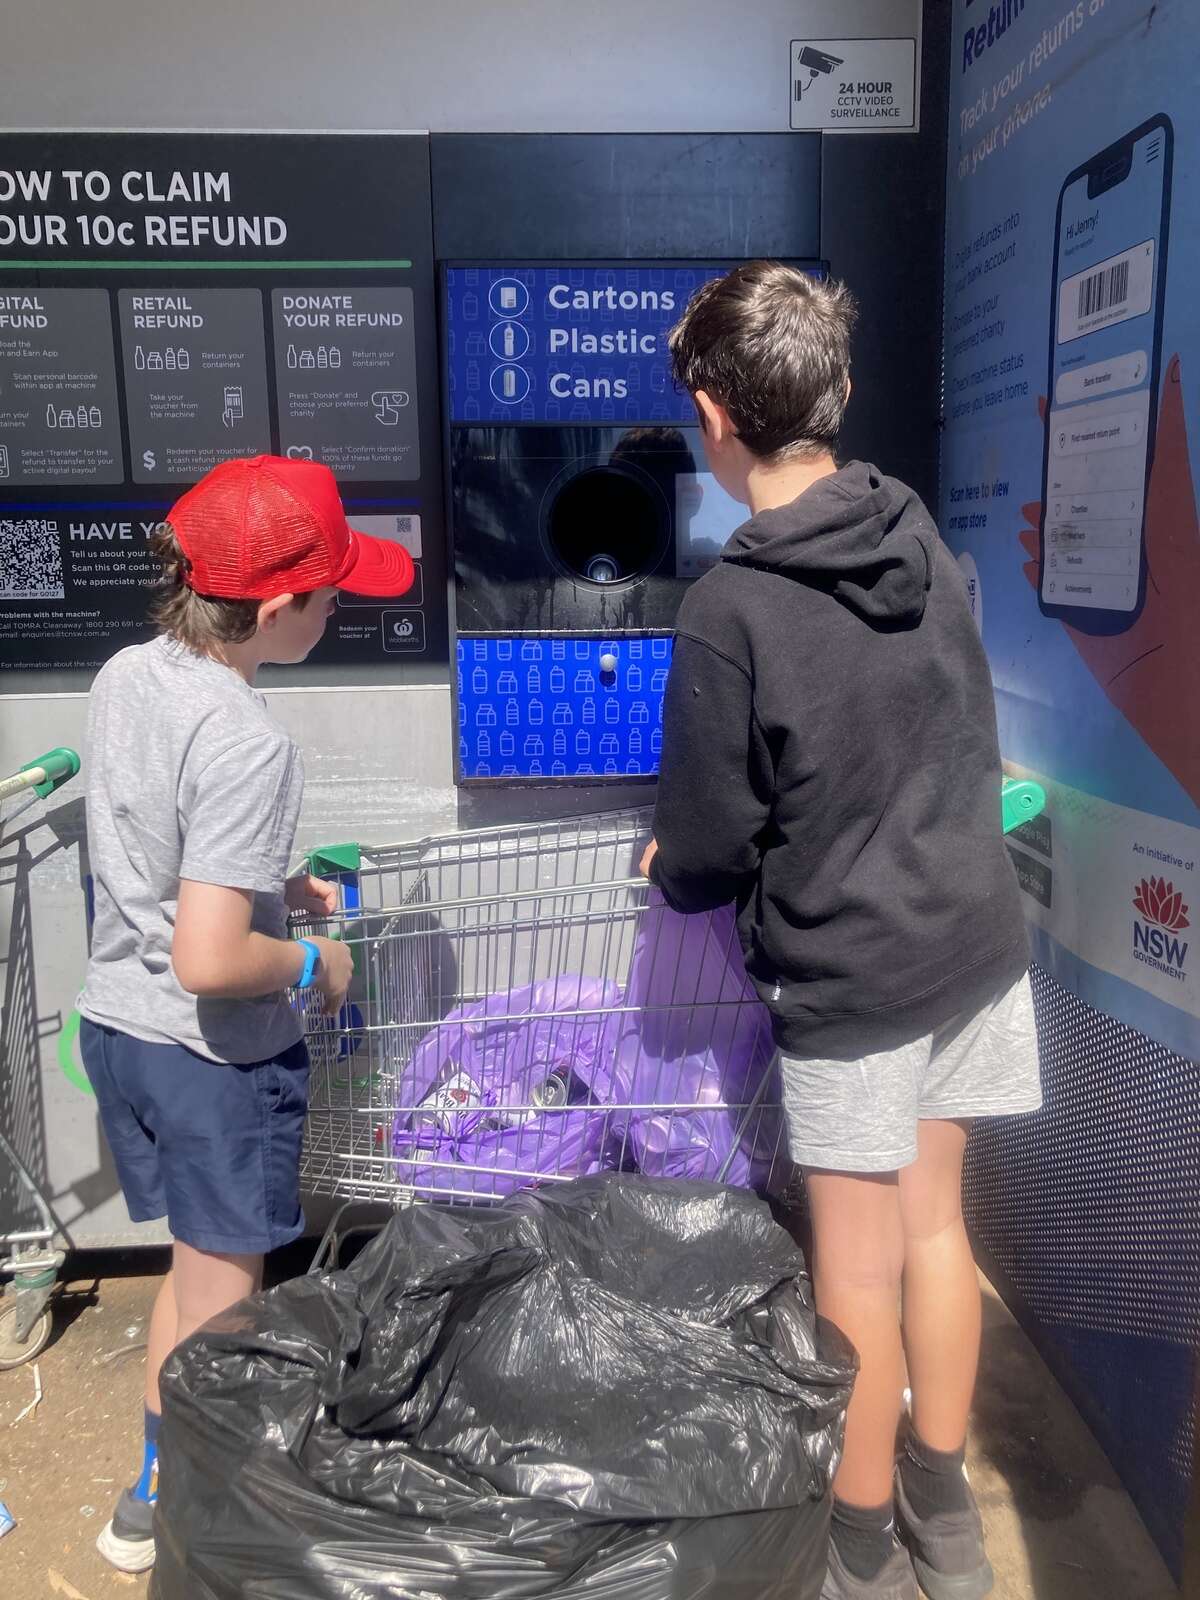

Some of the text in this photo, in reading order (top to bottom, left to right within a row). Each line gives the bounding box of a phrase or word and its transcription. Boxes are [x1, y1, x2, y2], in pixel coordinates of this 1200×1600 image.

[959, 3, 1084, 136] Track your returns
[838, 82, 893, 94] 24 HOUR
[837, 96, 894, 106] CCTV VIDEO
[830, 108, 901, 118] SURVEILLANCE
[971, 126, 1001, 175] your
[1002, 83, 1053, 149] phone.
[62, 171, 111, 202] TO
[121, 171, 232, 203] CLAIM
[76, 215, 135, 247] 10c
[145, 215, 288, 247] REFUND
[1066, 225, 1074, 240] Hi
[984, 241, 1016, 274] account
[282, 296, 353, 310] DONATE
[548, 284, 676, 311] Cartons
[132, 296, 192, 311] RETAIL
[134, 315, 204, 328] REFUND
[284, 313, 403, 327] YOUR REFUND
[19, 340, 31, 348] the
[549, 328, 657, 354] Plastic
[42, 350, 58, 359] App
[201, 352, 246, 361] Return your
[352, 351, 396, 360] Return your
[999, 352, 1025, 377] status
[34, 373, 66, 382] personal
[65, 382, 96, 390] machine
[549, 372, 629, 399] Cans
[1003, 380, 1028, 401] home
[149, 393, 184, 403] Take your
[150, 402, 179, 410] voucher
[317, 402, 333, 410] your
[335, 401, 369, 409] preferred
[13, 412, 29, 420] your
[290, 410, 315, 418] charity
[166, 448, 197, 456] Redeem
[199, 449, 214, 457] your
[97, 458, 114, 467] your
[393, 455, 402, 463] go
[47, 467, 70, 476] digital
[72, 467, 97, 476] payout
[331, 463, 356, 471] charity
[950, 487, 964, 502] Scan
[981, 482, 990, 499] to
[992, 479, 1010, 497] view
[969, 512, 987, 528] store
[69, 522, 133, 540] HAVE
[100, 550, 125, 558] about
[127, 551, 147, 560] your
[71, 562, 161, 572] Scan this QR code to
[73, 578, 87, 586] We
[89, 578, 135, 588] appreciate
[137, 579, 158, 588] your
[43, 622, 82, 631] Cleanaway
[86, 620, 104, 628] 1800
[1132, 842, 1194, 870] An initiative of
[1133, 920, 1189, 969] NSW
[1133, 949, 1187, 982] GOVERNMENT
